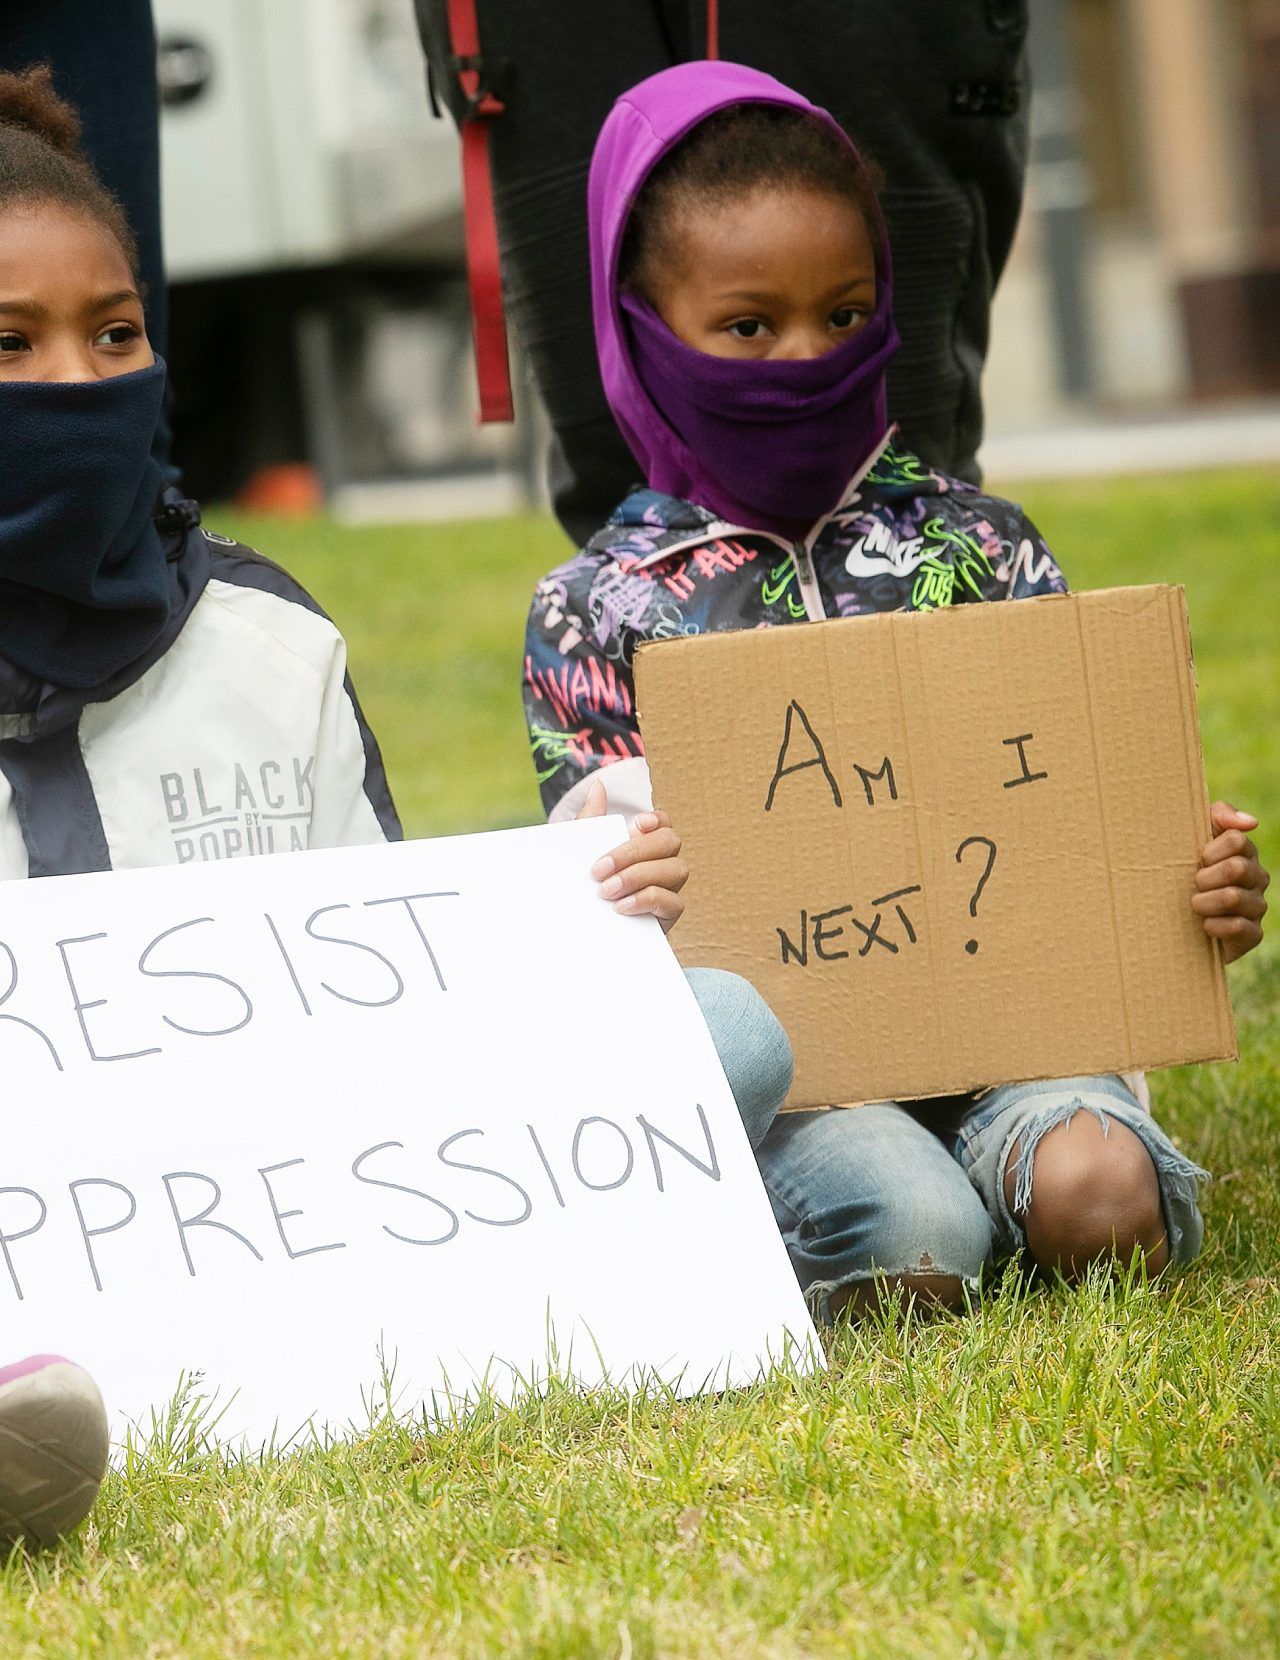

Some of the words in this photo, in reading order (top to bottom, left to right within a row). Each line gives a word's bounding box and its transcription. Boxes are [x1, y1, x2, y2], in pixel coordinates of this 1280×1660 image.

[863, 521, 924, 571] NIKE
[1002, 733, 1048, 789] I
[160, 756, 315, 823] BLACK
[244, 812, 260, 827] BY
